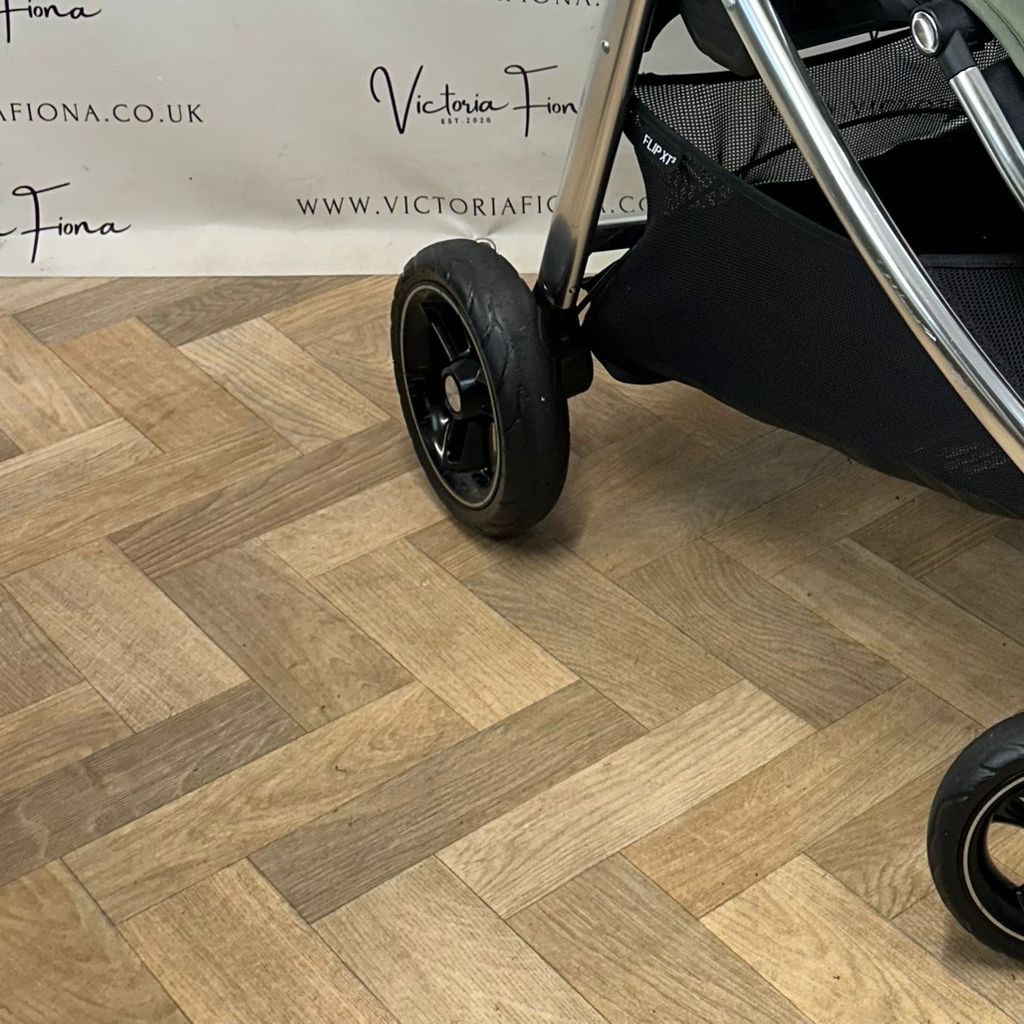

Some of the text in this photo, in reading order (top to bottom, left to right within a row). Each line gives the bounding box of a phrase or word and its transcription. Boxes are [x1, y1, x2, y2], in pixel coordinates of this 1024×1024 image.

[368, 64, 511, 136] Victoria
[440, 113, 492, 125] EST.2020
[642, 133, 663, 155] FLIP
[10, 181, 133, 265] Fiona
